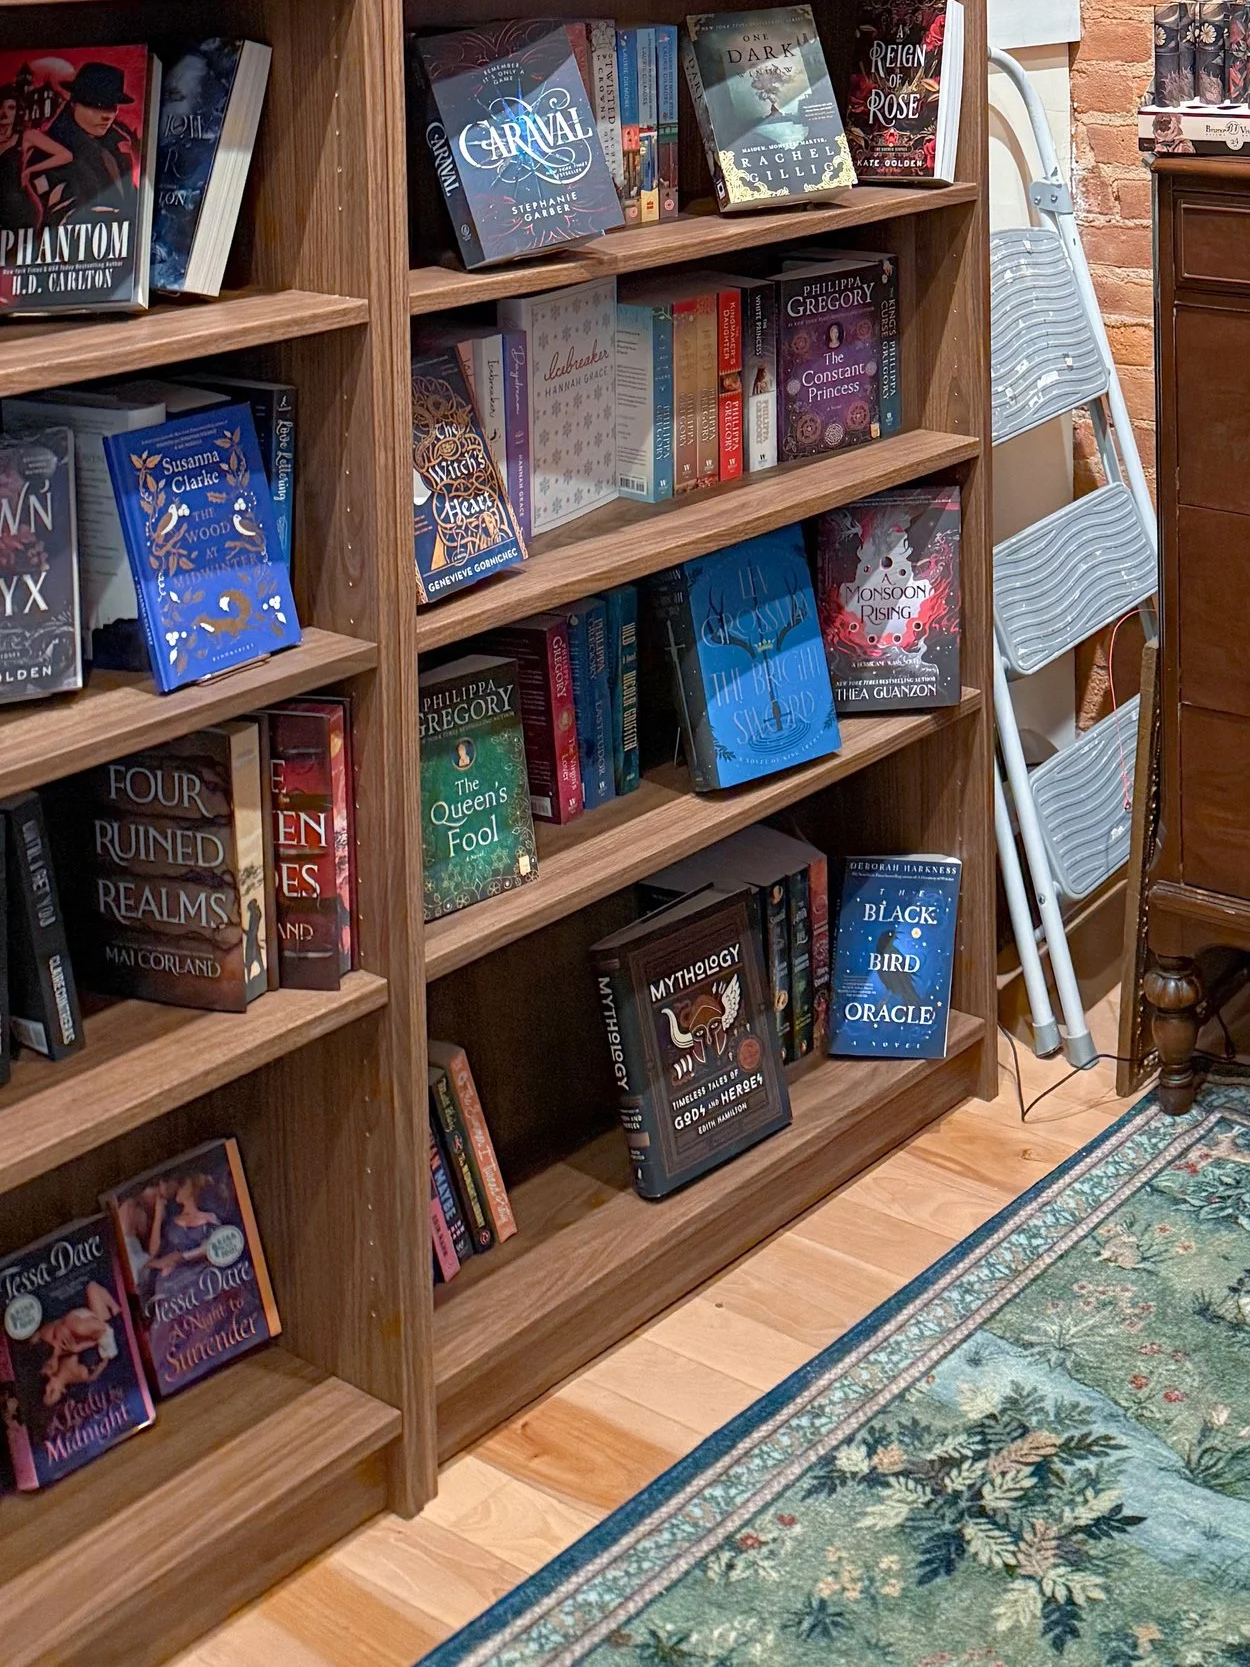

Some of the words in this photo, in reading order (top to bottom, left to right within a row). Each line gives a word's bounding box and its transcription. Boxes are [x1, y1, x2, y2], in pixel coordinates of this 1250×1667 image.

[727, 43, 796, 64] DARK
[742, 34, 769, 43] ONE
[737, 65, 793, 79] WINDOW
[870, 40, 926, 74] REIGN
[889, 74, 903, 87] OF
[867, 89, 920, 128] ROSE
[458, 107, 593, 169] CARAVAL
[1205, 124, 1226, 134] Bruno
[741, 146, 835, 168] RACHEL
[750, 162, 834, 183] GILLIG
[857, 159, 882, 167] KATE
[512, 191, 578, 215] STEPHANIE
[524, 204, 571, 222] GARBER
[0, 220, 130, 267] PHANTOM
[12, 274, 42, 295] H.D.
[48, 269, 113, 292] CARLTON
[803, 276, 862, 295] PHILIPPA
[787, 283, 875, 317] GREGORY
[544, 339, 610, 382] Icebreaker
[802, 360, 865, 387] Constant
[824, 353, 844, 366] The
[510, 345, 527, 415] Daydream
[545, 377, 582, 397] HANNAH
[584, 368, 609, 384] GRACE
[808, 380, 860, 403] Princess
[276, 420, 293, 448] Love
[724, 401, 732, 452] GREGORY
[162, 450, 220, 475] Susanna
[274, 451, 293, 502] Lettering
[428, 450, 487, 484] Witch's
[171, 470, 220, 495] Clarke
[192, 508, 216, 522] THE
[446, 492, 494, 523] Heart
[184, 520, 231, 544] WOOD
[172, 554, 261, 587] MIDWINTER
[428, 566, 473, 593] GENEVIEVE
[474, 548, 518, 573] GORNICHEC
[846, 584, 927, 604] MONSOON
[701, 591, 814, 647] GROSSMAN
[860, 604, 912, 624] RISING
[552, 636, 568, 698] GREGORY
[752, 645, 822, 696] BRIGHT
[424, 679, 496, 711] PHILIPPA
[709, 667, 748, 708] THE
[836, 687, 869, 701] THEA
[873, 684, 937, 699] GUANZON
[623, 705, 639, 753] GRIFFITH
[732, 690, 815, 745] SWORD
[108, 764, 212, 818] FOUR
[454, 777, 480, 799] The
[430, 784, 508, 827] Queen's
[95, 820, 225, 868] RUINED
[448, 815, 500, 858] Fool
[851, 861, 900, 872] DEBORAH
[904, 863, 957, 874] HARKNESS
[98, 879, 229, 928] REALMS
[863, 903, 938, 925] BLACK
[106, 946, 135, 965] MAI
[138, 952, 222, 979] CORLAND
[650, 943, 740, 1003] MYTHOLOGY
[869, 952, 921, 973] BIRD
[845, 1001, 936, 1025] ORACLE
[598, 977, 630, 1091] MYTHOLOGY
[672, 1086, 707, 1111] TIMELESS
[721, 1074, 764, 1106] HEROES
[434, 1171, 457, 1221] MAYBE
[0, 1265, 51, 1302] Tessa
[51, 1236, 103, 1276] Dare
[145, 1291, 199, 1327] Tessa
[199, 1263, 251, 1301] Dare
[164, 1314, 257, 1383] Surrender
[63, 1391, 107, 1429] Lady
[44, 1404, 130, 1466] Midnight
